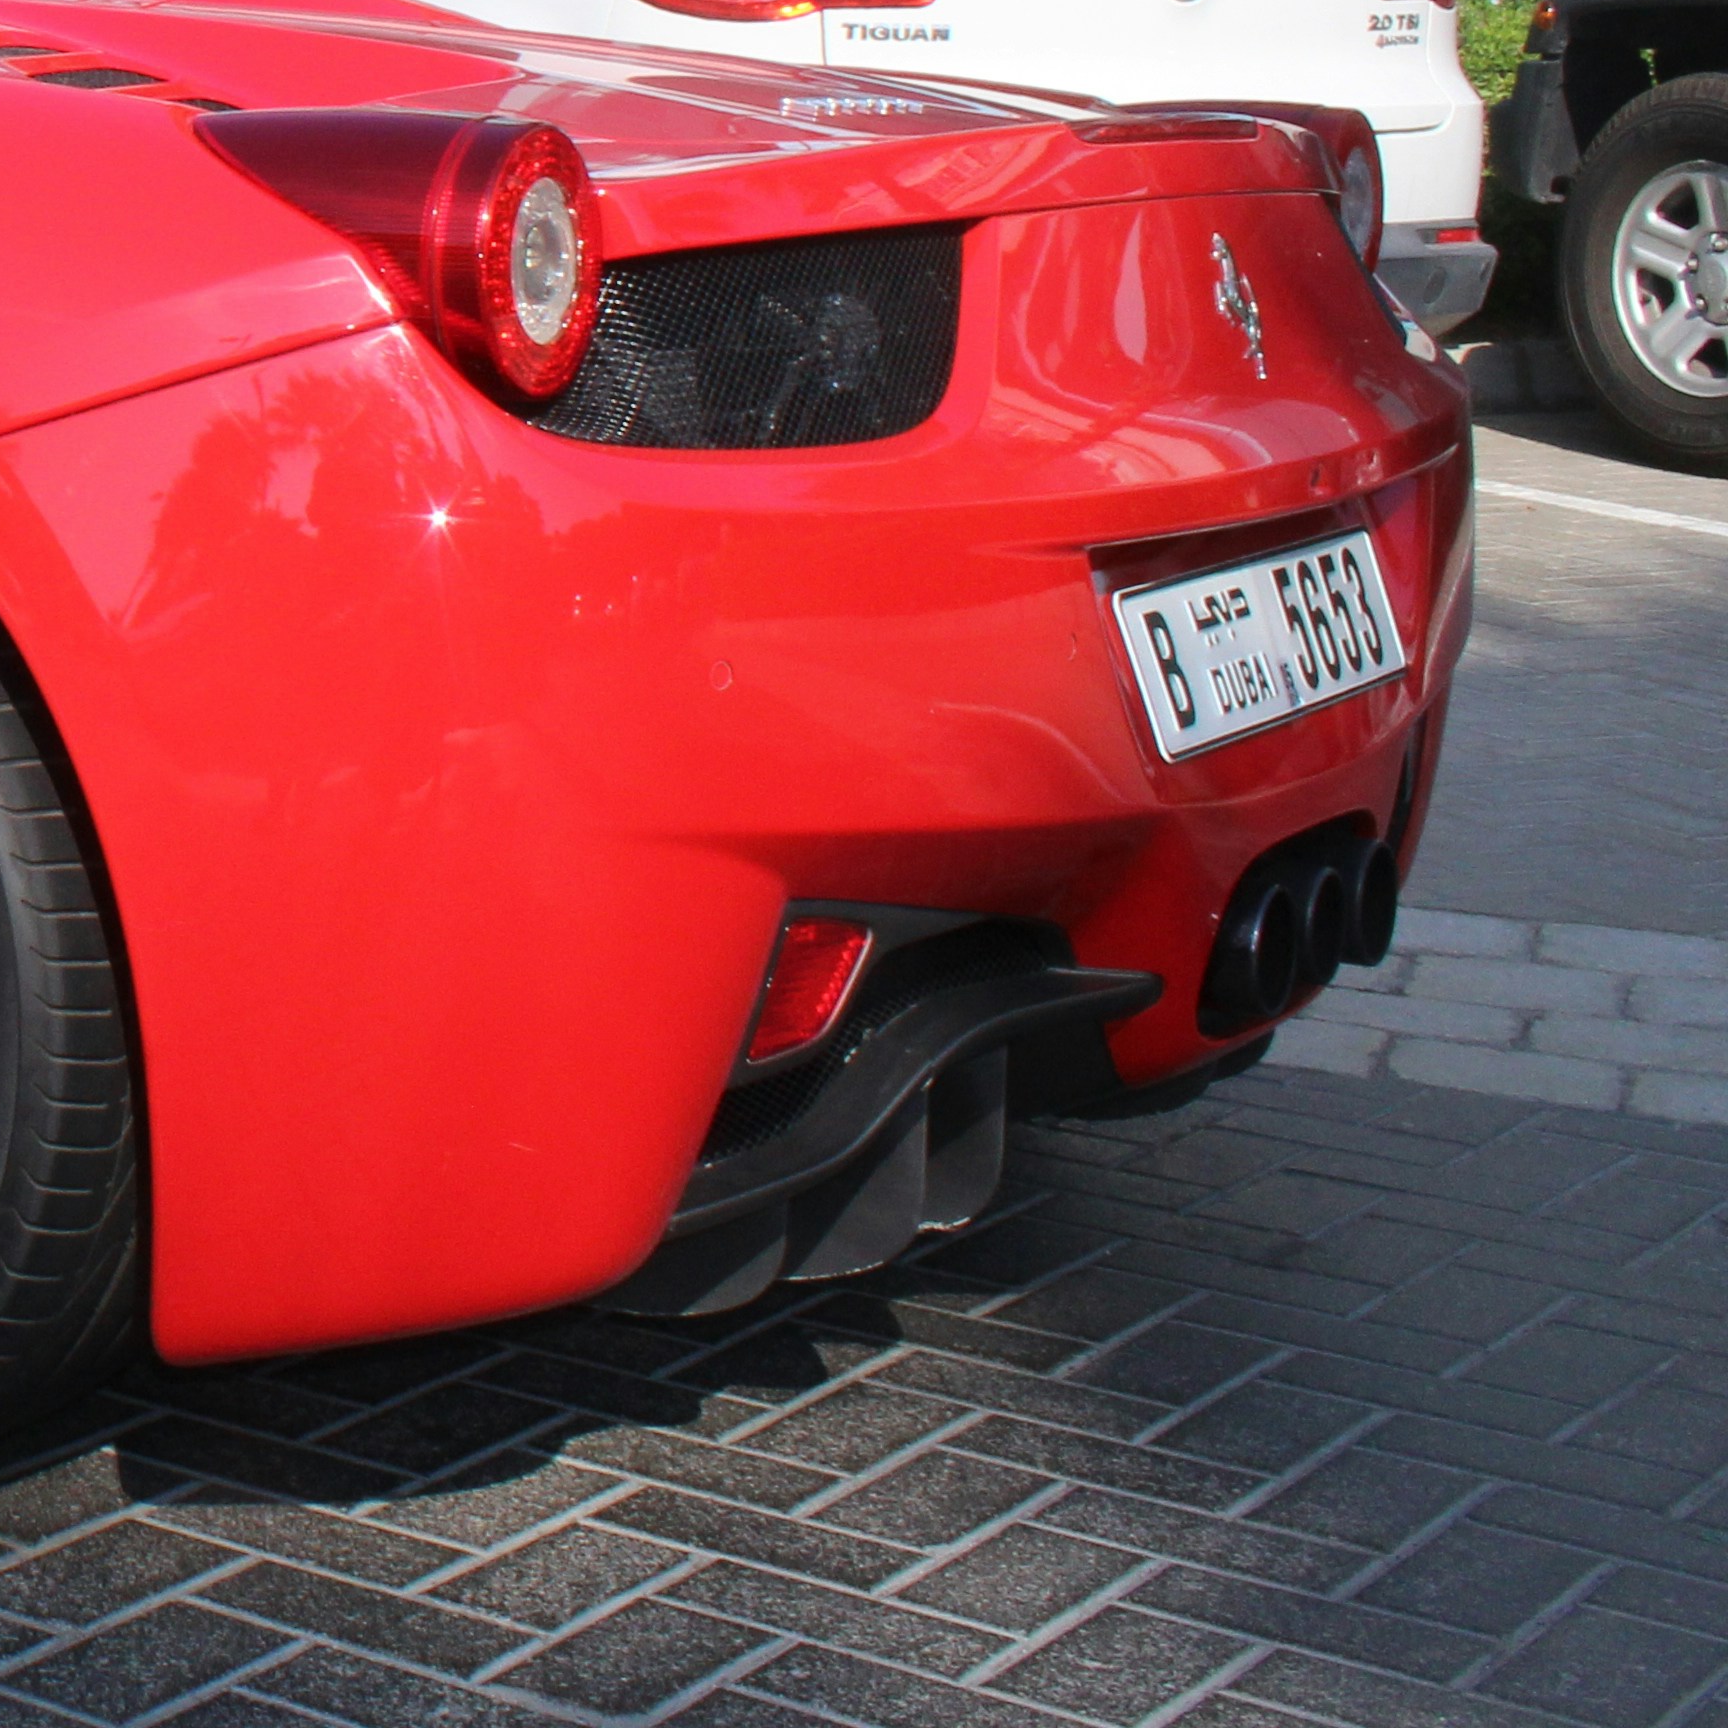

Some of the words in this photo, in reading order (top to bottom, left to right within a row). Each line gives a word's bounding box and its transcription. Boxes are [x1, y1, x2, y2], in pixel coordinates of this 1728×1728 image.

[842, 23, 951, 41] TIGUAN
[1271, 546, 1383, 690] 5653
[1142, 610, 1196, 731] B
[1207, 652, 1278, 715] DUBAI
